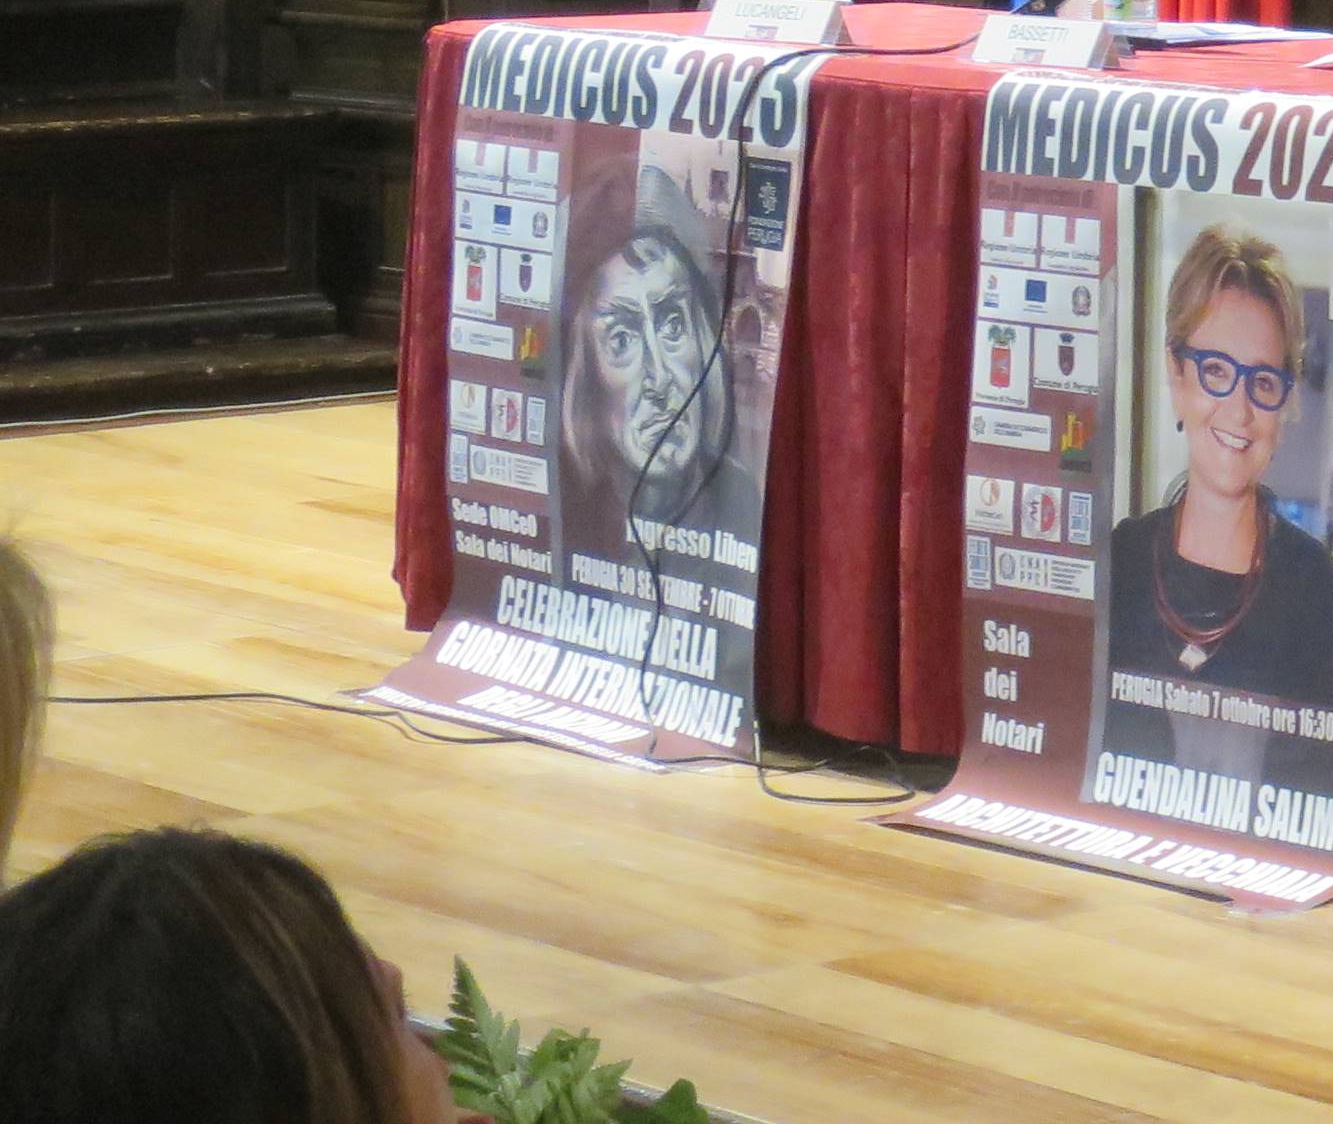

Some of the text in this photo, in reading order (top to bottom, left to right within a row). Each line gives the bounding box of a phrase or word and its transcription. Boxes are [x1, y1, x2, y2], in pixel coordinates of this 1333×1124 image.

[1008, 24, 1069, 42] BASSETTI
[464, 29, 816, 148] MEDICUS 2023
[986, 81, 1230, 193] MEDICUS
[452, 497, 488, 526] Sede
[455, 530, 552, 574] Sala dei Notari
[497, 575, 718, 681] CELEBRAZIONE DELLA
[983, 619, 1030, 658] Sala
[436, 621, 561, 688] GIORNATA
[547, 649, 744, 748] INTERNAZIONALE
[983, 667, 1018, 702] dei
[1111, 671, 1163, 708] PERUGIA
[1165, 681, 1210, 718] Sabato
[1211, 691, 1221, 718] 7
[1272, 707, 1296, 734] ore
[982, 711, 1044, 755] Notari
[1094, 751, 1252, 834] GUENDALINA
[915, 794, 1147, 859] ARCHITETTURA
